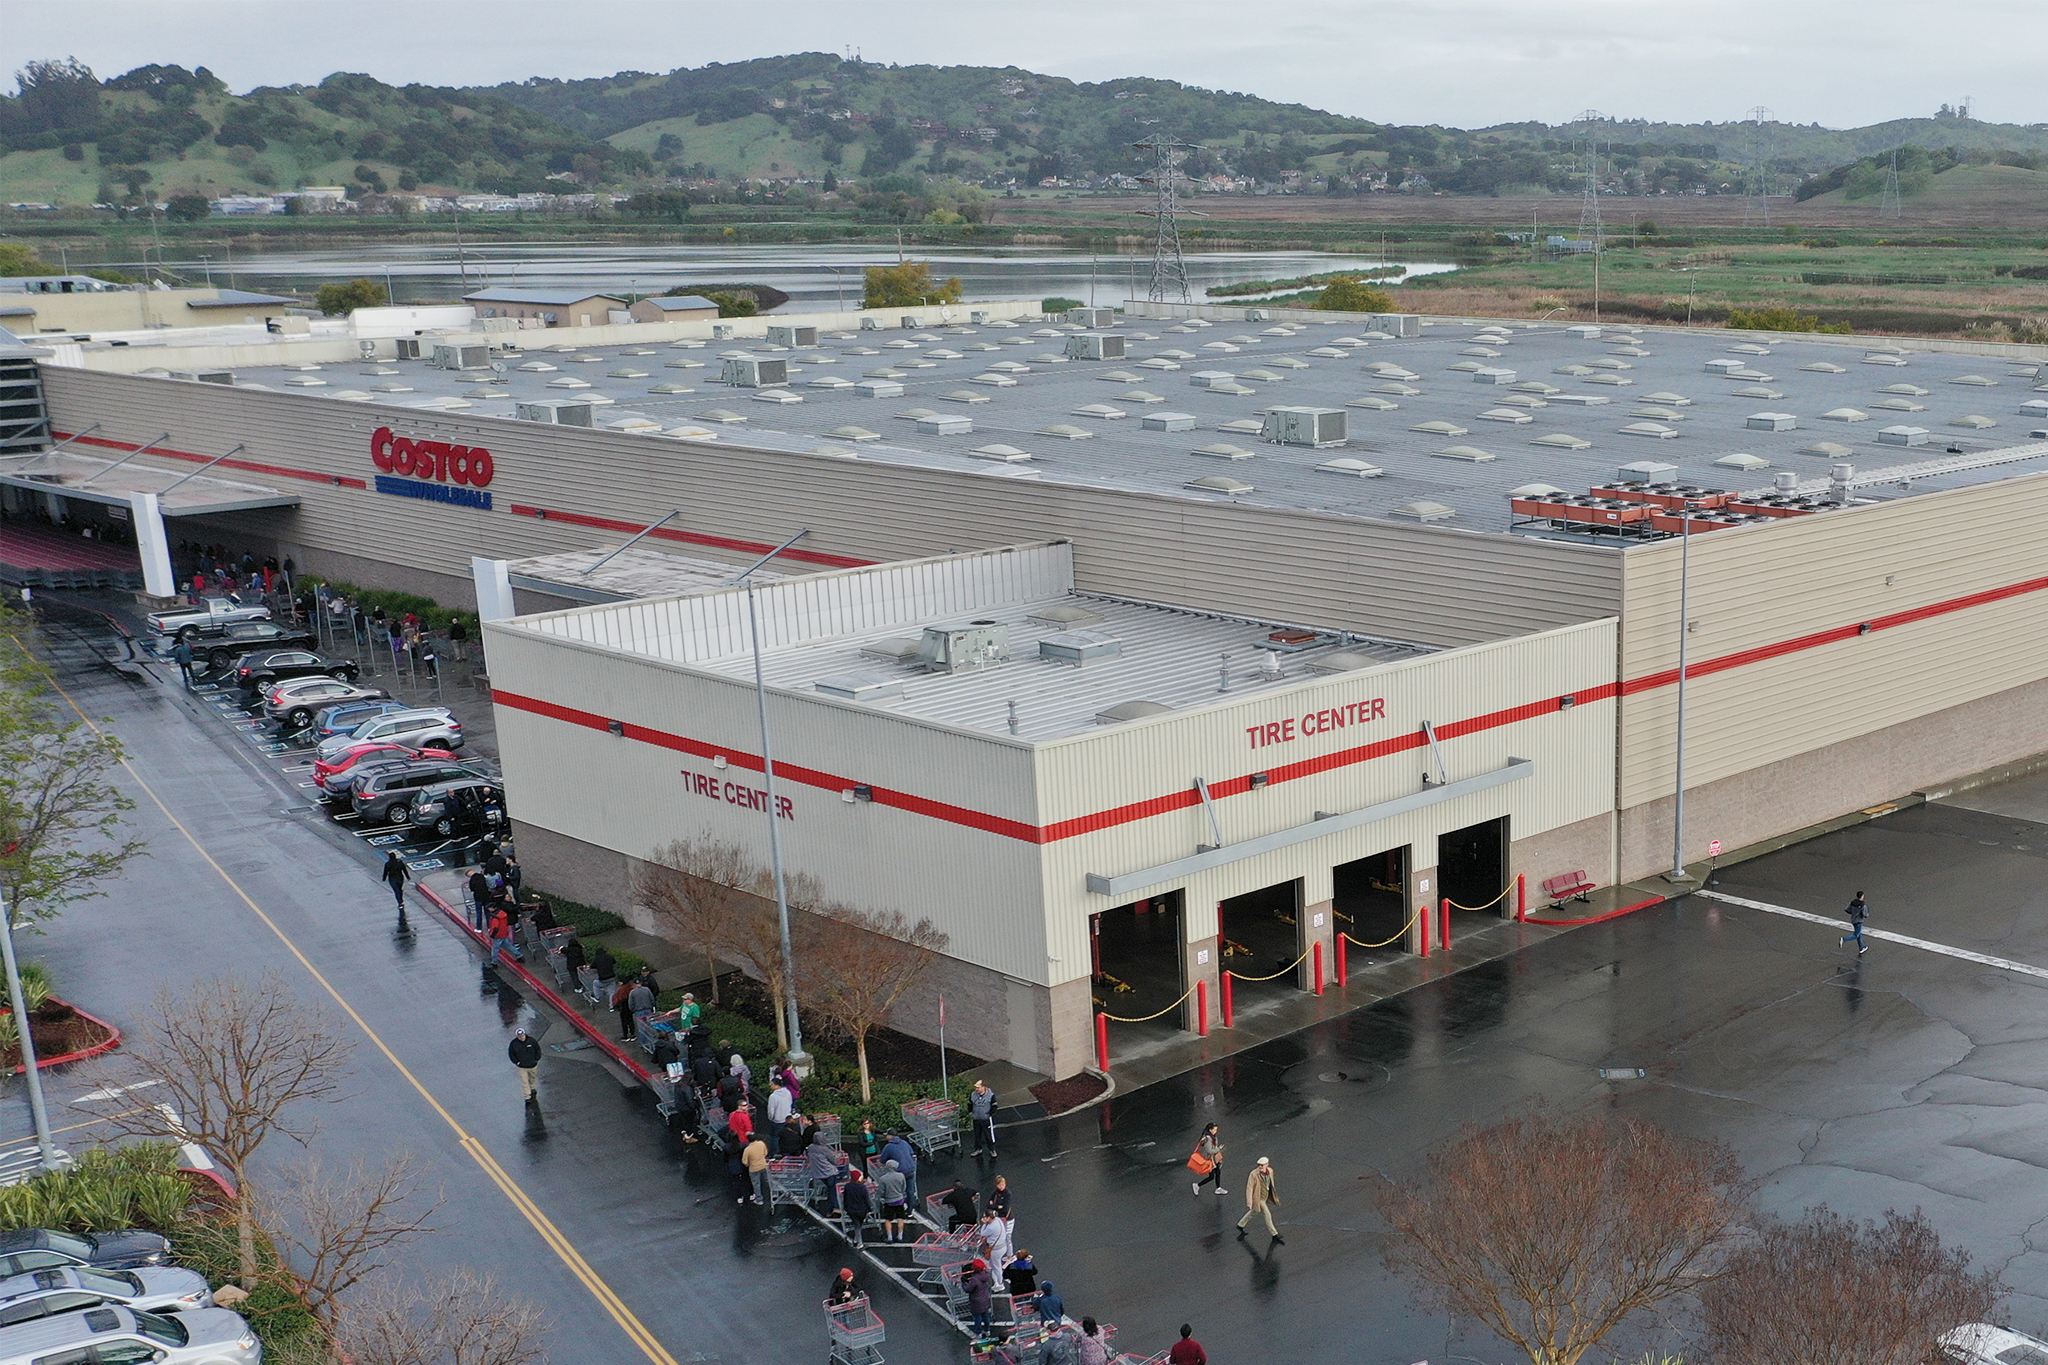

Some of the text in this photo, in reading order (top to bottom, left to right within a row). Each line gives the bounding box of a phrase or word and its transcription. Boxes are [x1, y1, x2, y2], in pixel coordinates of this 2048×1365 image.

[371, 427, 494, 487] COSTCO
[410, 481, 493, 510] WHOLESALE
[1246, 698, 1386, 749] TIRE CENTER
[681, 770, 720, 800] TIRE
